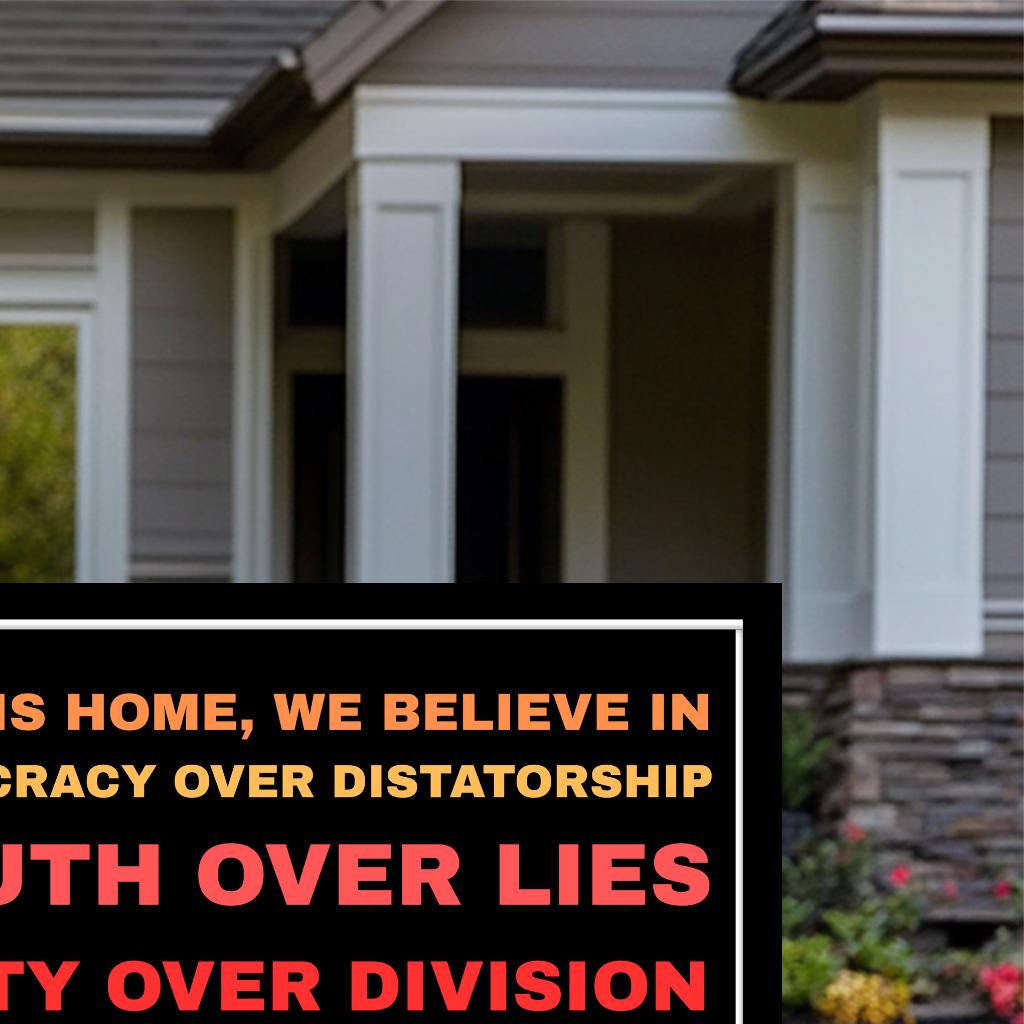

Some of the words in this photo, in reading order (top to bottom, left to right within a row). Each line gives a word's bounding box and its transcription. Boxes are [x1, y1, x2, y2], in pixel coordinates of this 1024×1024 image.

[68, 693, 253, 740] HOME,
[274, 694, 361, 730] WE
[384, 694, 628, 730] BELIEVE
[652, 694, 708, 730] IN
[175, 765, 314, 798] OVER
[334, 765, 712, 798] DISTATORSHIP
[198, 843, 461, 906] OVER
[499, 843, 710, 906] LIES
[108, 960, 320, 1011] OVER
[351, 960, 704, 1011] DIVISION
